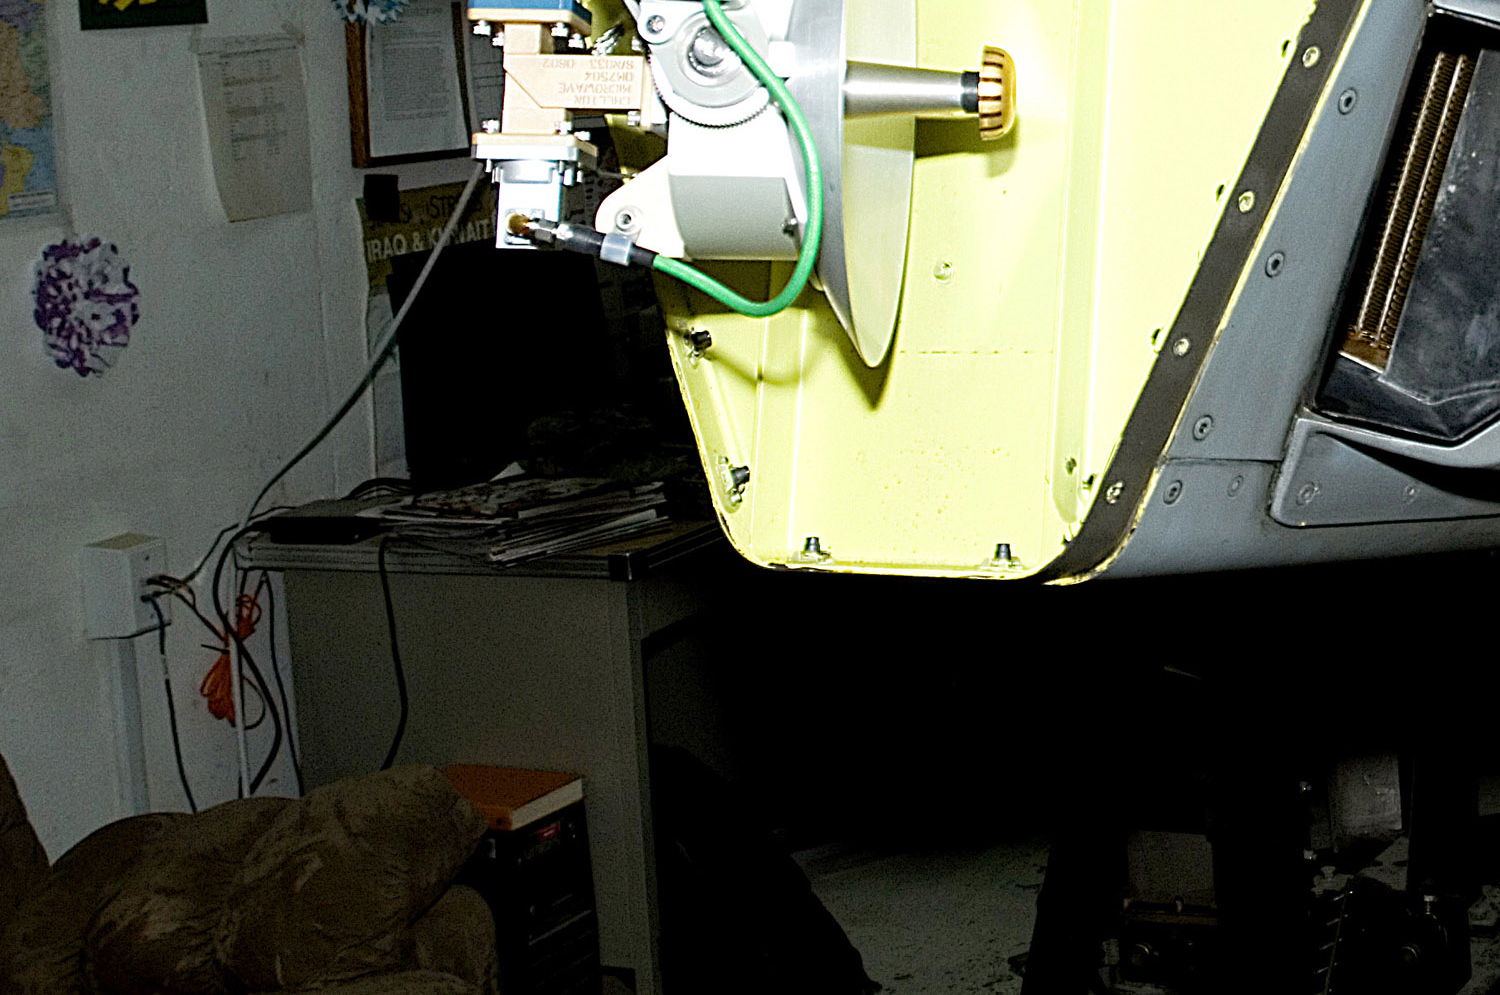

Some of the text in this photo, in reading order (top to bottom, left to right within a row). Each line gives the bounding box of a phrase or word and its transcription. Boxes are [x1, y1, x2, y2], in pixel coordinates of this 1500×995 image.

[366, 218, 490, 264] IRAQ & KAIT
